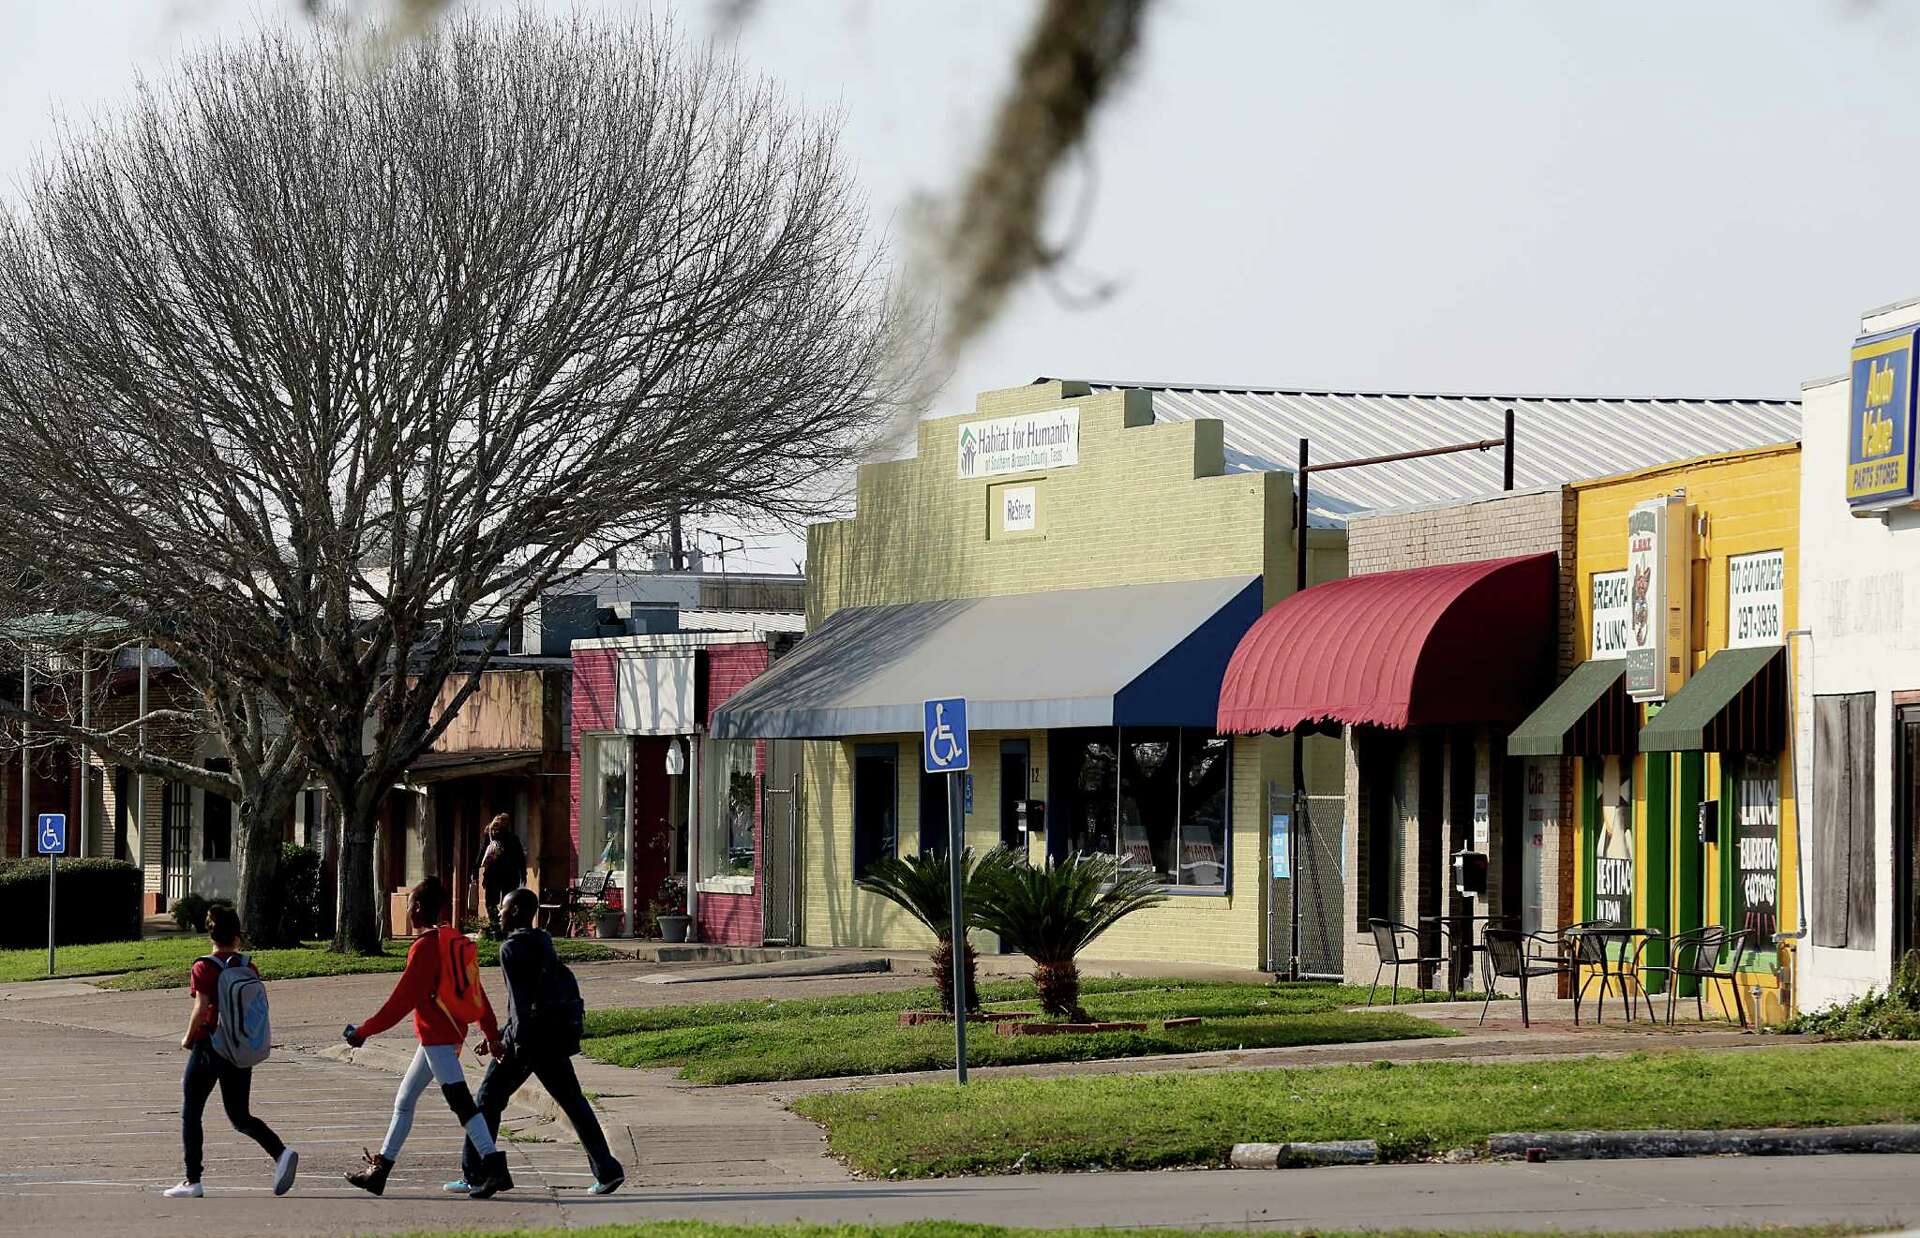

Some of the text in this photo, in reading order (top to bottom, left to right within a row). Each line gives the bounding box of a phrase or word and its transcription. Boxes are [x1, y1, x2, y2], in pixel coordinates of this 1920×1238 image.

[1866, 358, 1895, 408] Auto
[978, 416, 1072, 455] Habitat for Humanity
[1862, 408, 1894, 458] Value
[1007, 499, 1032, 521] ReStore
[1731, 557, 1784, 595] TO GO ORDER
[1596, 621, 1602, 651] &
[1738, 603, 1779, 639] 297-3938
